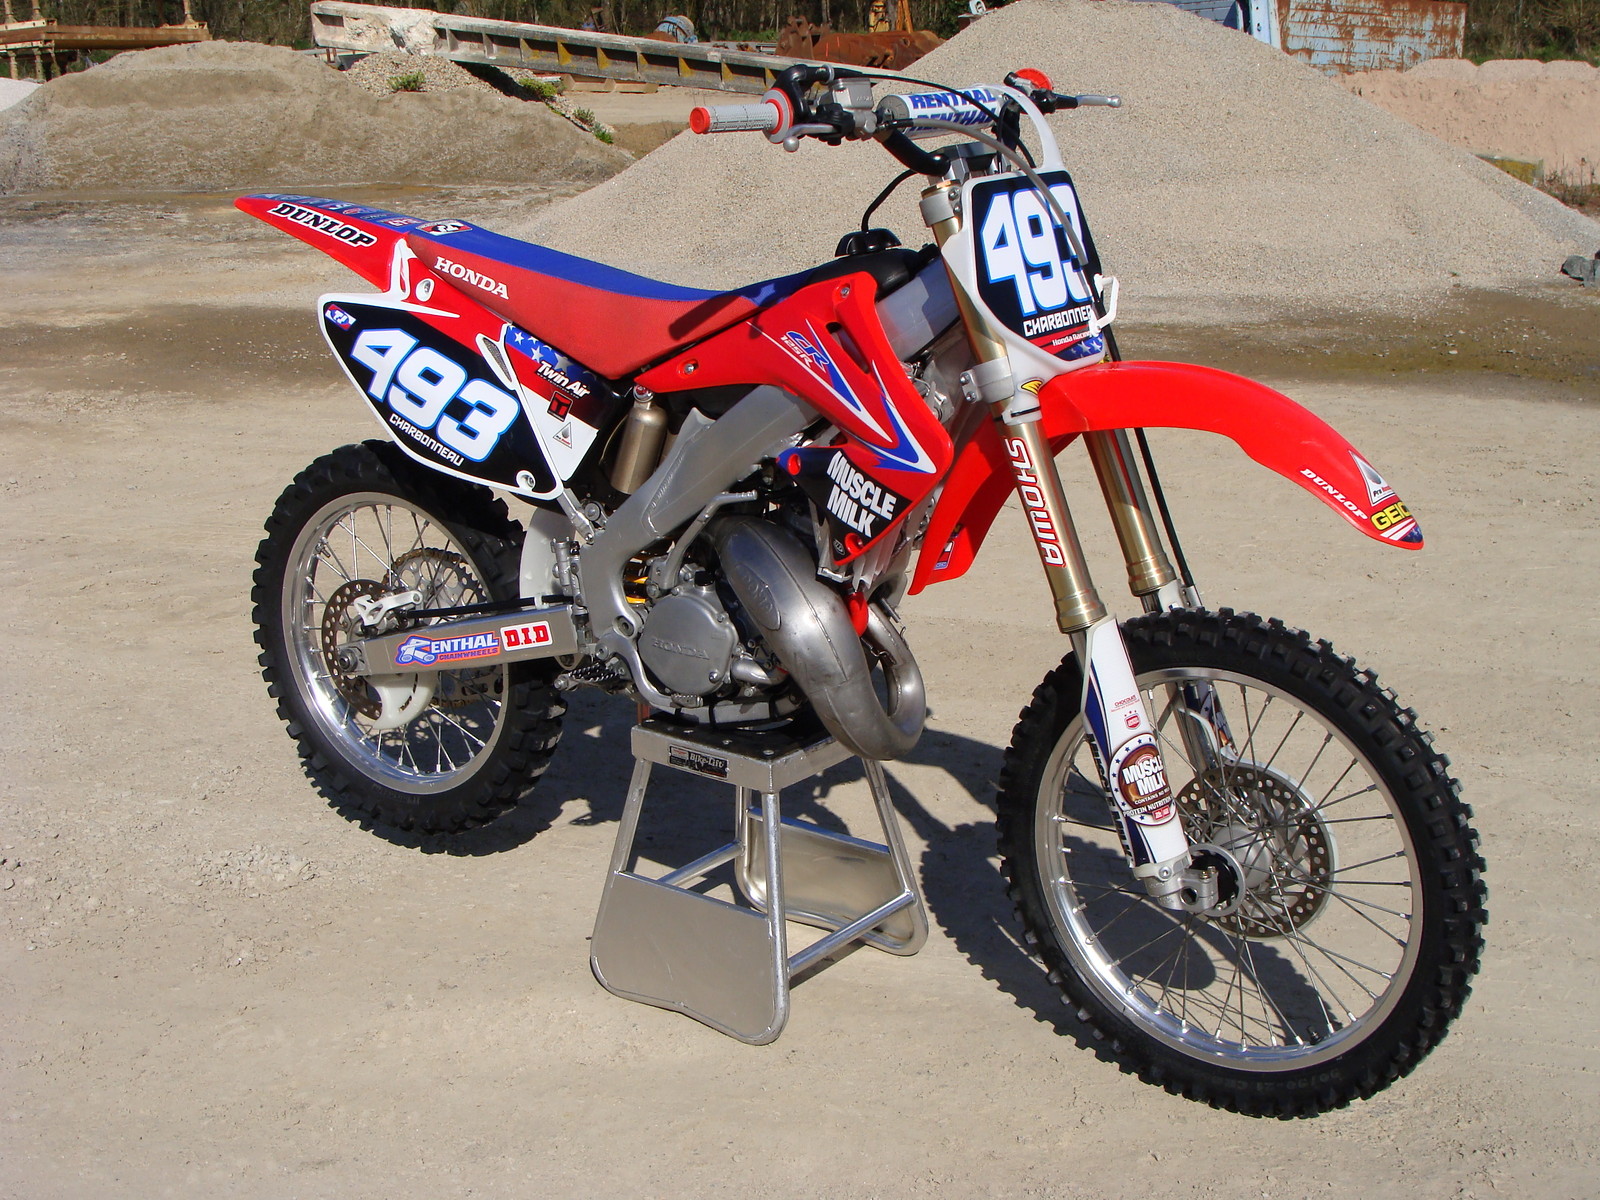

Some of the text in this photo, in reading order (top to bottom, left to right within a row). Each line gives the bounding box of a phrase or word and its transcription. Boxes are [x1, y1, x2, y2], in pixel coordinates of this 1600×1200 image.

[269, 203, 377, 248] DUNLOP
[434, 256, 509, 300] HONDA
[1052, 335, 1073, 346] Honda
[351, 328, 520, 462] 493
[537, 361, 570, 387] Twin
[566, 381, 590, 398] Air
[389, 413, 464, 467] CHARBONNEAU
[826, 450, 897, 520] MUSCLE
[1004, 437, 1066, 567] SHOWA
[1300, 468, 1368, 520] DUNLOP
[826, 484, 877, 538] MILK
[439, 647, 498, 661] CHAINWHEELS
[504, 625, 550, 647] D.I.D
[651, 638, 710, 660] HONDA
[1136, 771, 1166, 796] MILK
[1123, 806, 1147, 817] PROTEIN
